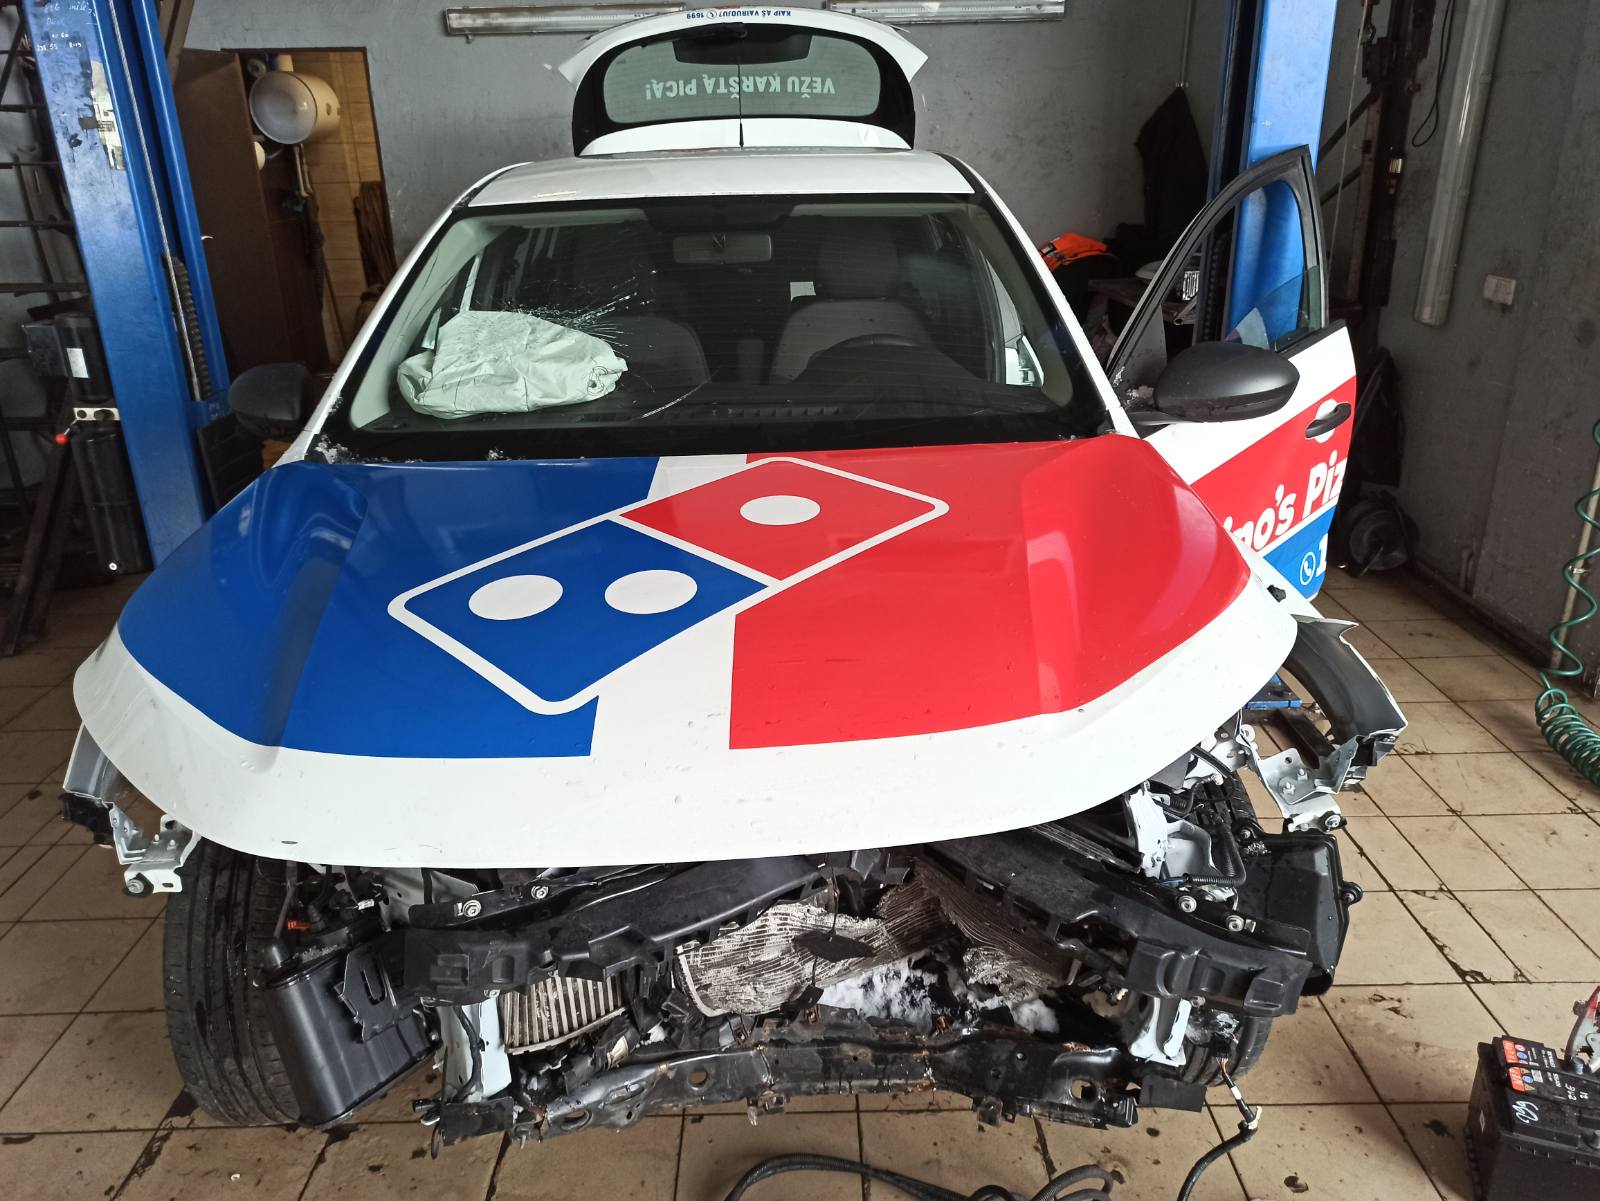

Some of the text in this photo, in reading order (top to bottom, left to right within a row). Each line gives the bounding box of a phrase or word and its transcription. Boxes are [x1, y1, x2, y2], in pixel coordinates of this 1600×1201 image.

[761, 10, 772, 18] AŠ
[645, 74, 836, 101] VEŽU KARŠTĄ PICĄ!
